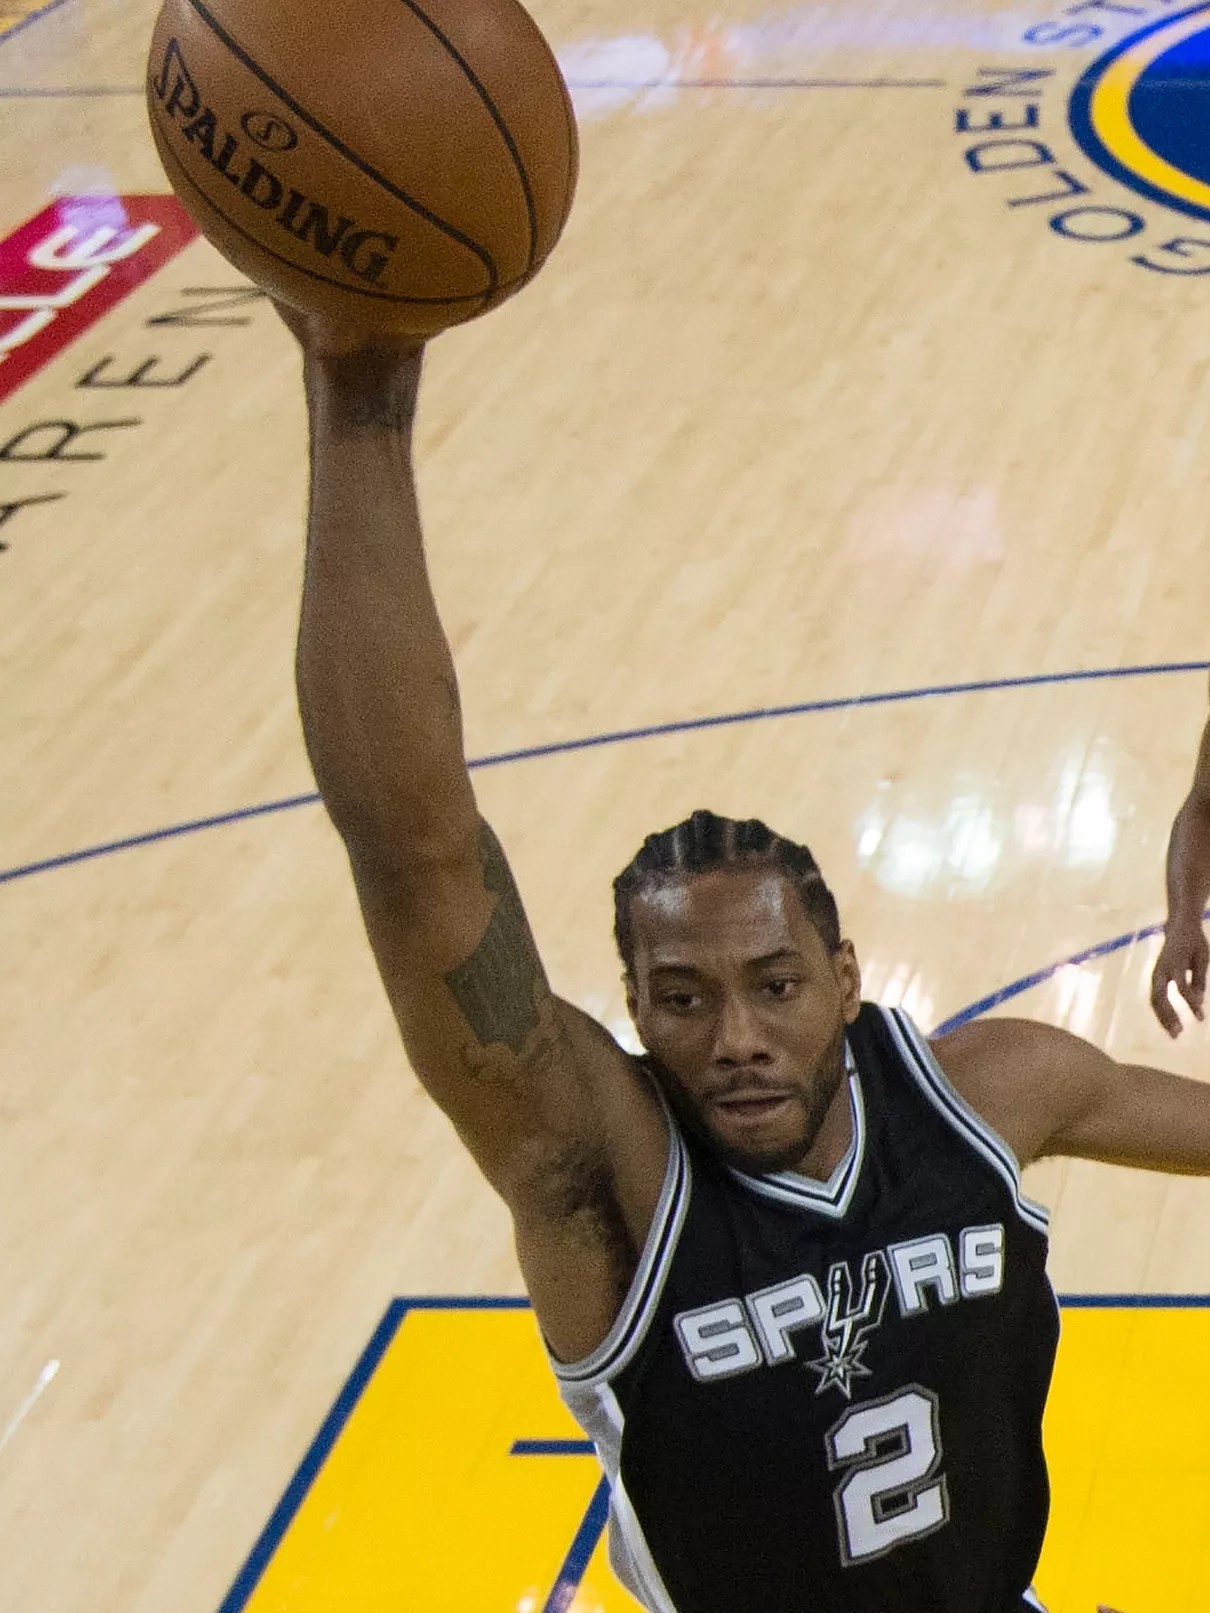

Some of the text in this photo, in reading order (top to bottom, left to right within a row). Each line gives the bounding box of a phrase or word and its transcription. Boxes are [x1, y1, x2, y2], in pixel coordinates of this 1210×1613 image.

[154, 37, 399, 287] SPALDING
[673, 1223, 1005, 1399] SPURS
[824, 1382, 950, 1568] 2
